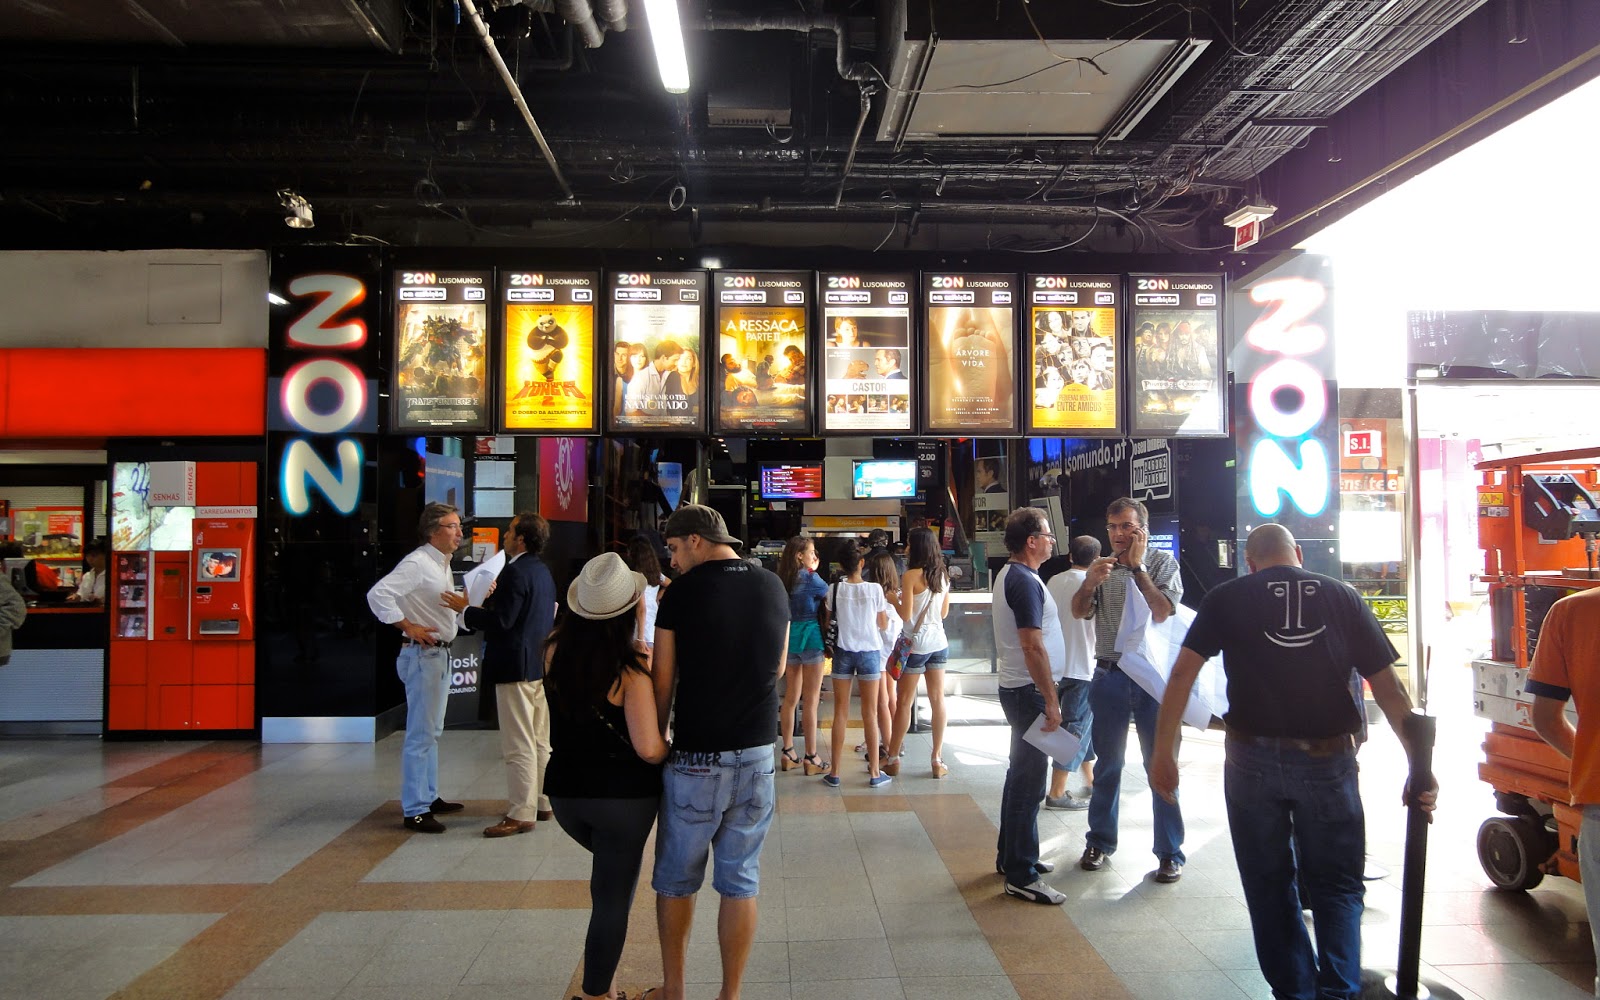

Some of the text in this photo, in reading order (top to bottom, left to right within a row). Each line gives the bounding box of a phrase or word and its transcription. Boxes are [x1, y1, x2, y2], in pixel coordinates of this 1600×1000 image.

[403, 272, 436, 284] ZON
[511, 274, 544, 286] ZON
[618, 273, 651, 285] ZON
[724, 276, 756, 288] ZON
[828, 276, 860, 288] ZON
[932, 276, 964, 288] ZON
[1035, 276, 1068, 288] ZON
[1137, 278, 1169, 290] ZON
[725, 319, 799, 332] A RESSACA
[745, 332, 773, 342] PARTE
[852, 382, 887, 392] CASTOR
[281, 274, 367, 515] ZON
[1249, 277, 1330, 516] ZON
[541, 395, 556, 407] 2
[624, 400, 689, 410] NAMORADO
[1056, 401, 1077, 412] ENTRE
[1350, 437, 1371, 450] S.I.
[153, 493, 181, 501] SENHAS
[450, 653, 479, 669] iosk
[452, 670, 478, 686] ON
